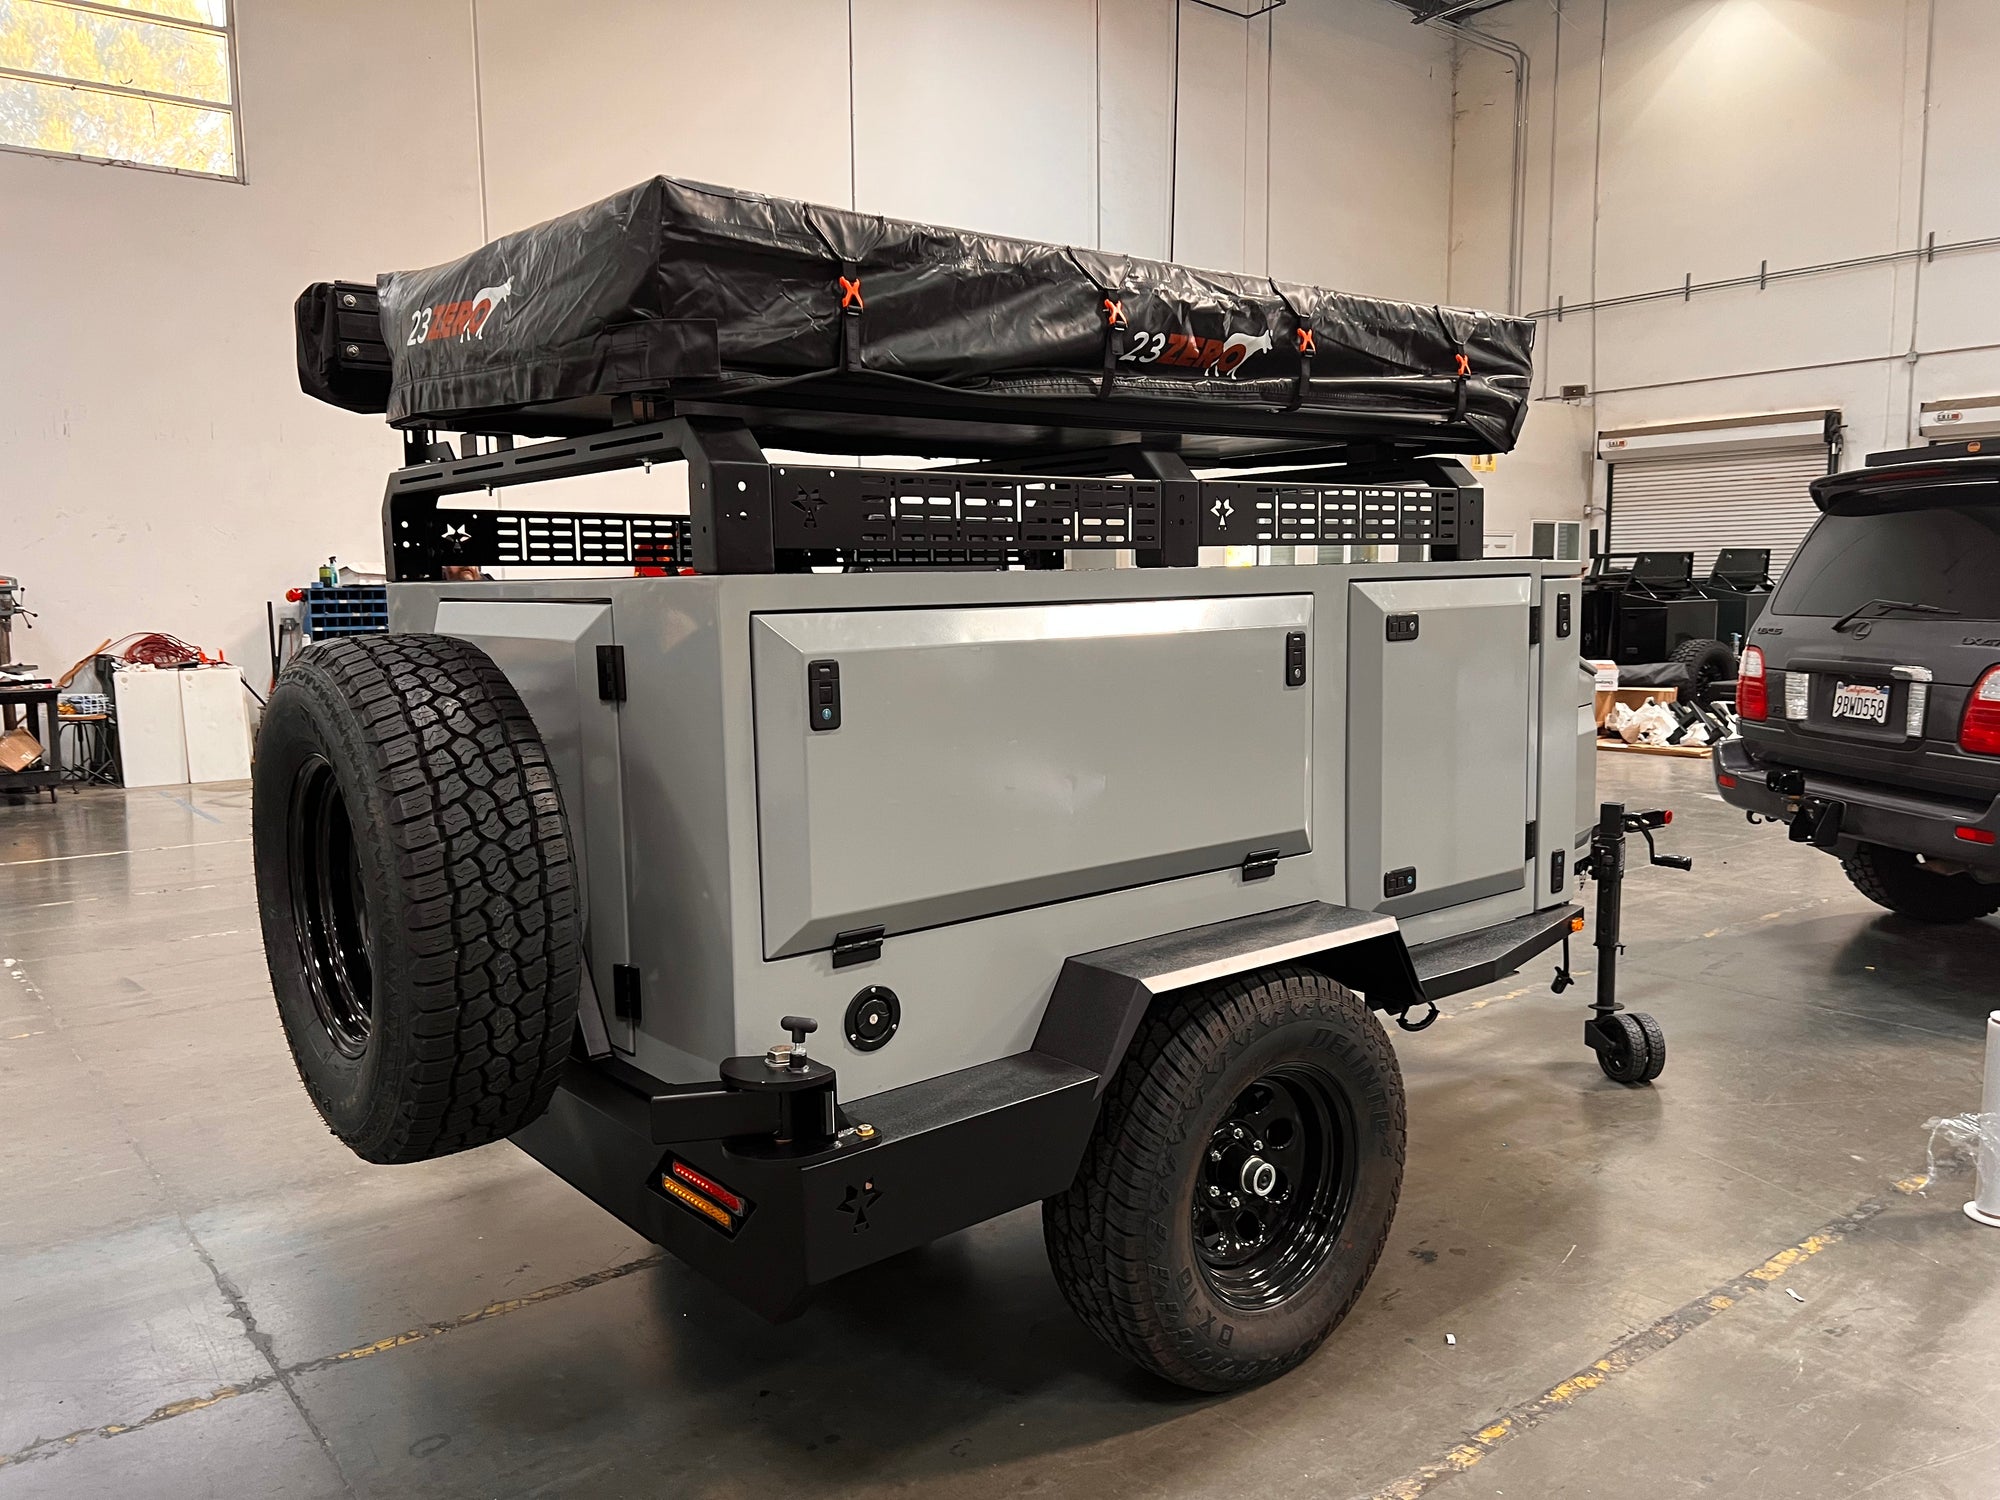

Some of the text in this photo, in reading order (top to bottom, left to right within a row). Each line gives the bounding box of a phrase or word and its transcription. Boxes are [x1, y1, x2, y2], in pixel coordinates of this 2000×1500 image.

[406, 297, 492, 347] 23ZERO
[1119, 331, 1247, 372] 23ZERO
[1835, 695, 1885, 718] 9BWD558
